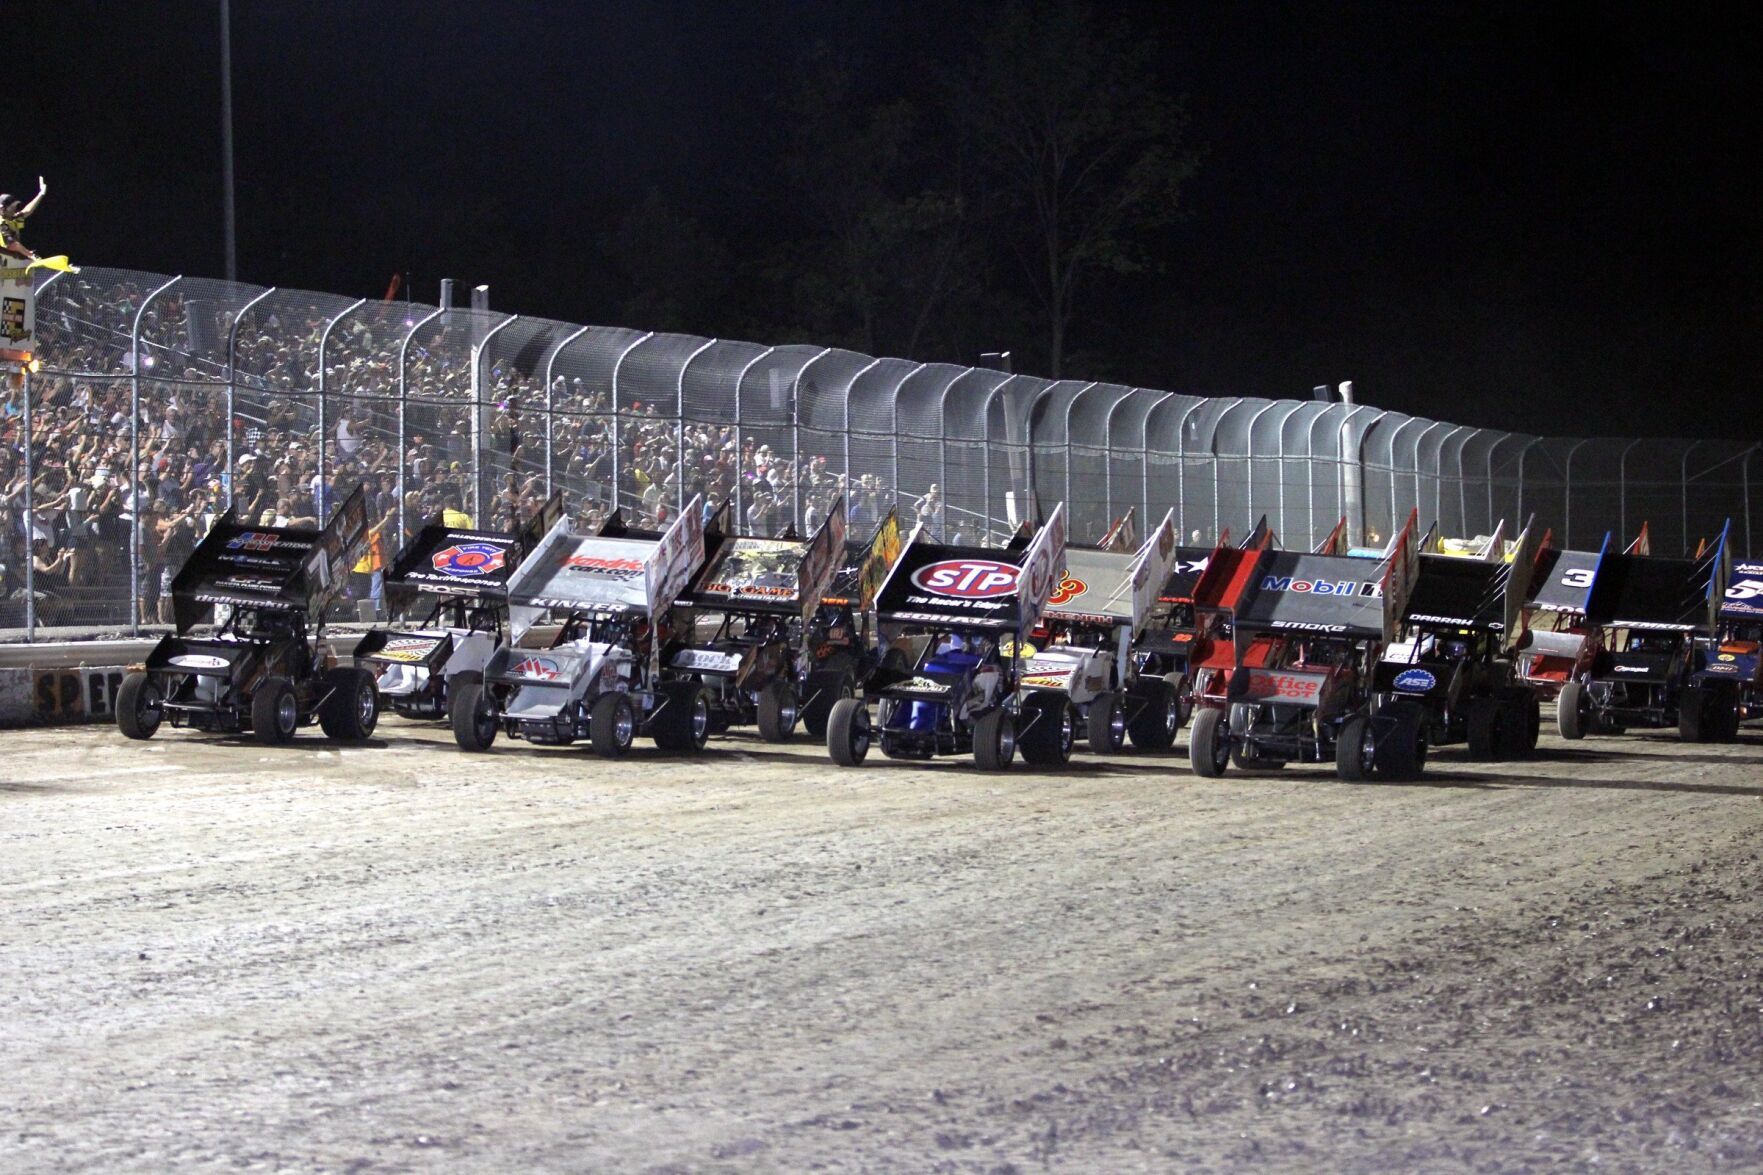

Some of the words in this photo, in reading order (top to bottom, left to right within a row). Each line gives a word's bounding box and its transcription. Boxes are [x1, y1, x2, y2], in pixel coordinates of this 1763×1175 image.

[926, 564, 1013, 591] STP
[1561, 568, 1596, 588] 3
[741, 586, 798, 599] GAME
[1260, 576, 1356, 596] Mobil
[529, 598, 628, 613] KINSER
[906, 595, 929, 604] The
[928, 597, 973, 608] Racer's
[1409, 613, 1474, 626] DARRAH
[1398, 677, 1430, 687] ASE
